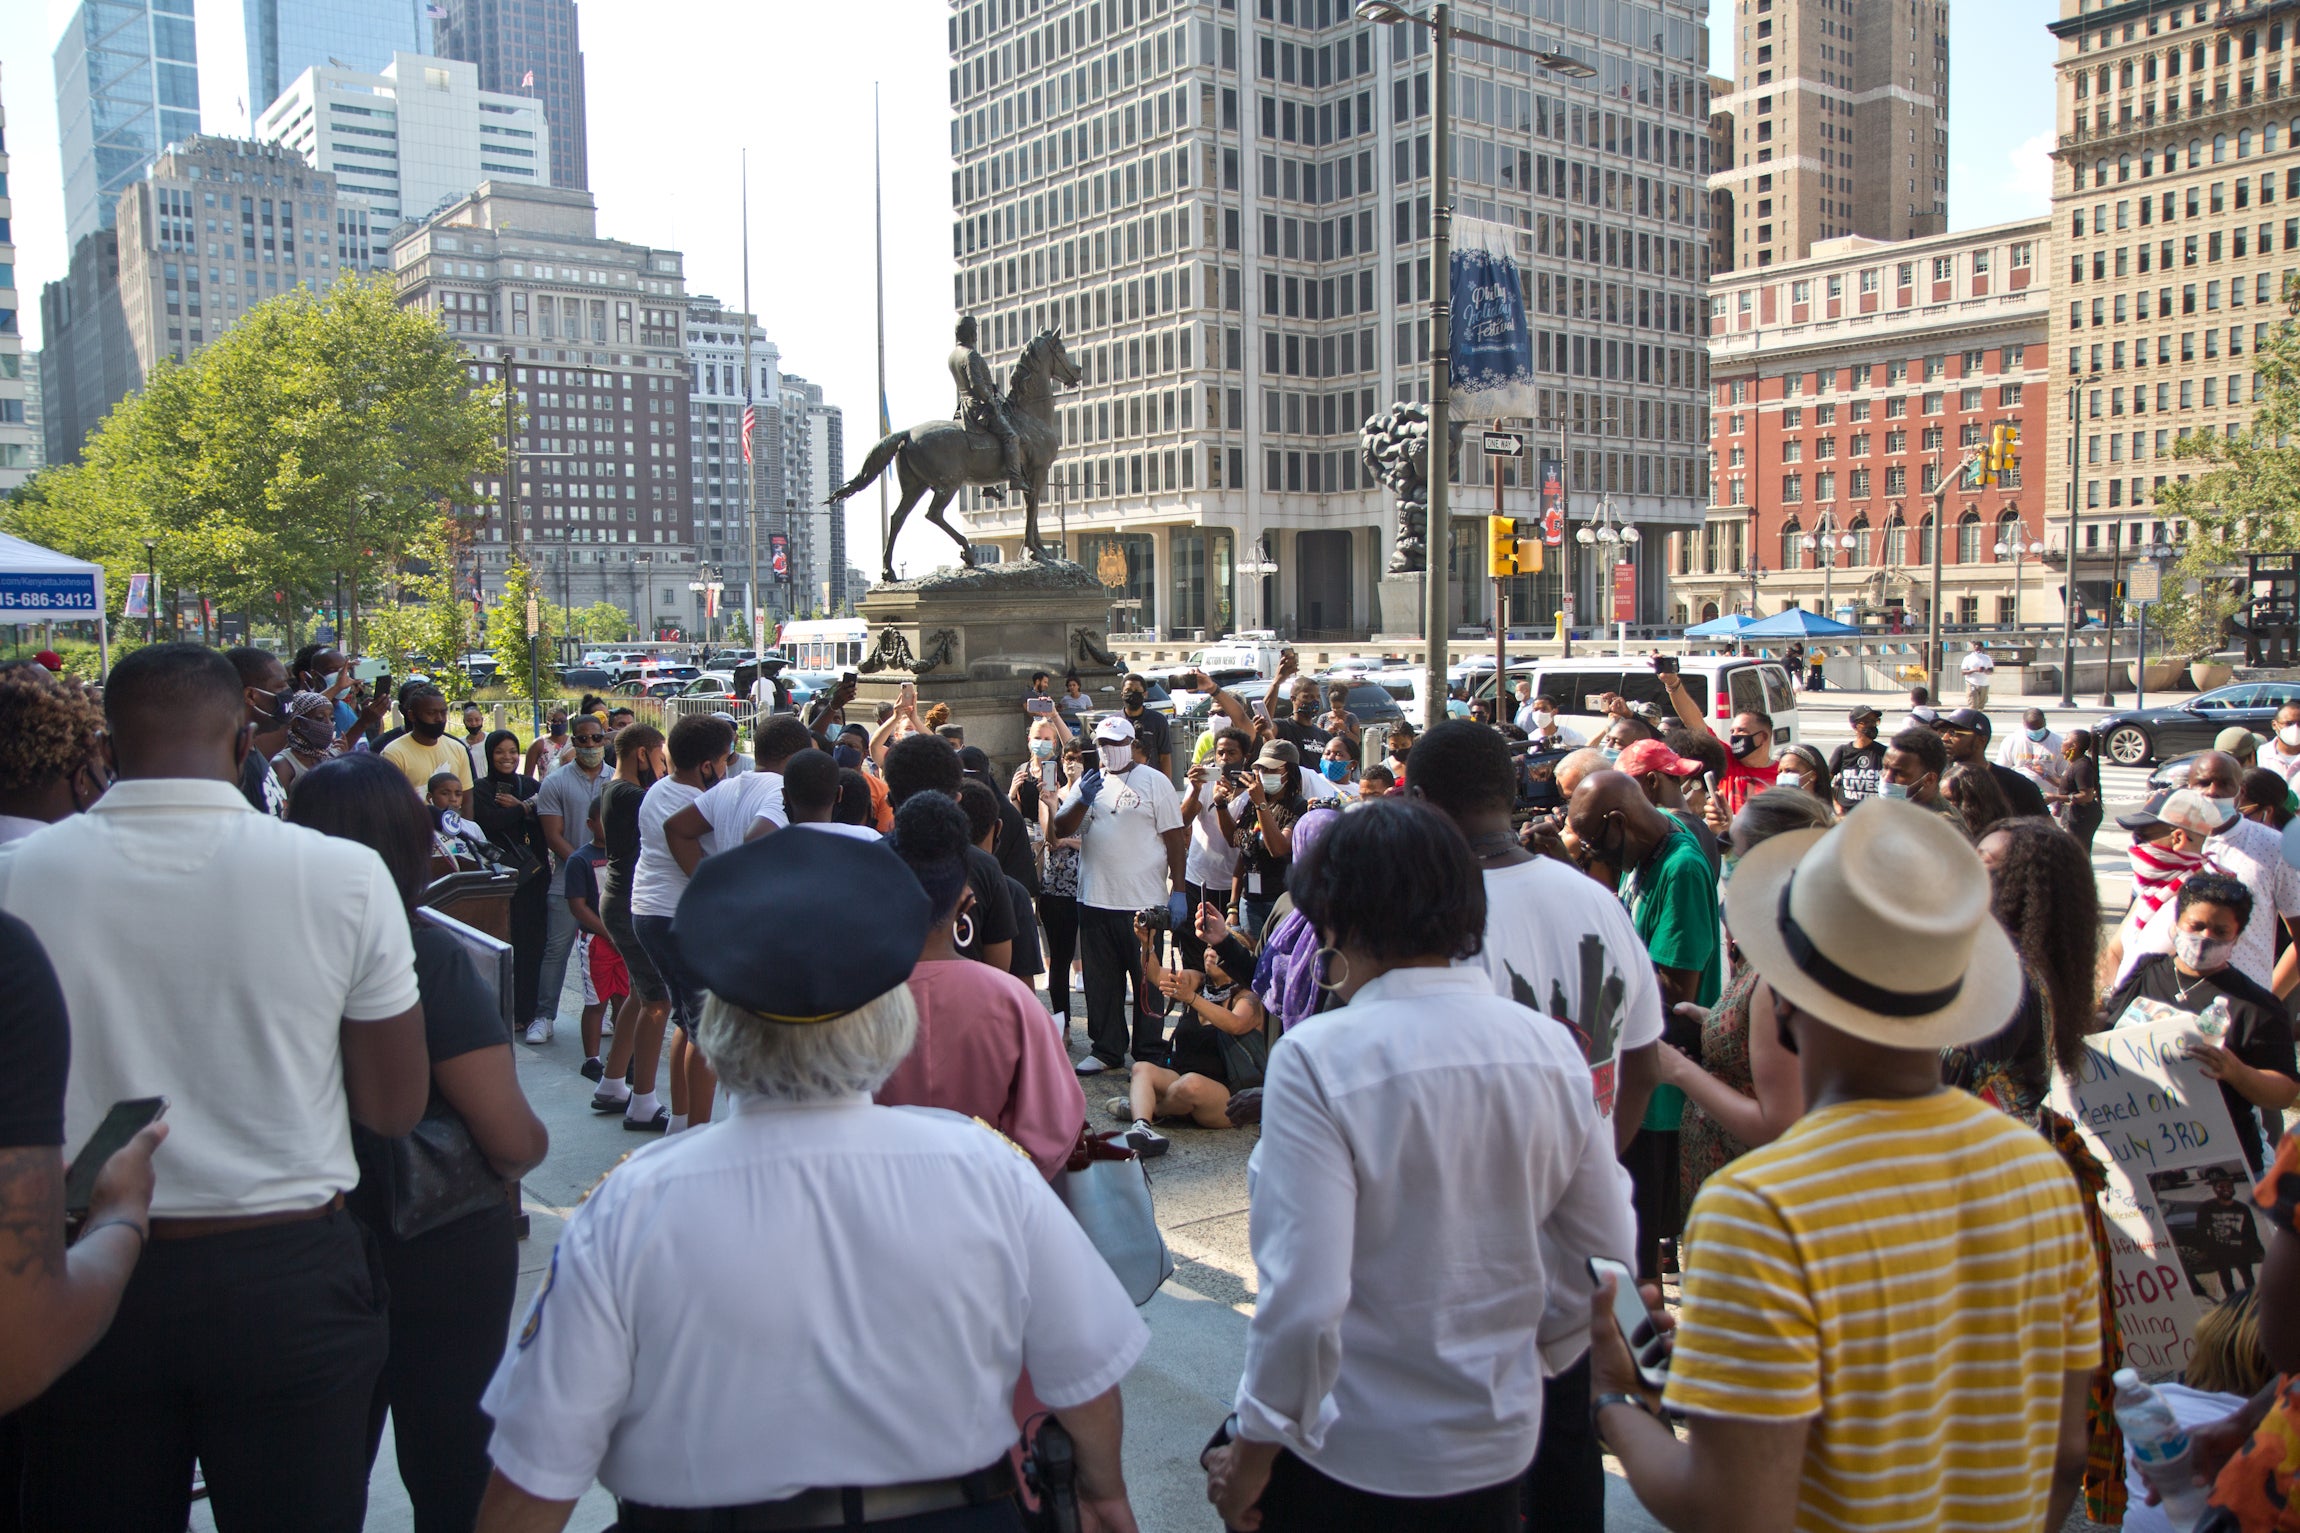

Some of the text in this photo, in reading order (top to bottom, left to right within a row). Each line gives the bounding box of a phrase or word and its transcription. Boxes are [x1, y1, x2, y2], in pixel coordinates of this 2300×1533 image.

[1472, 283, 1506, 309] Philly
[1463, 302, 1512, 327] Holiday
[1473, 318, 1515, 342] Festival
[1487, 438, 1512, 450] ONE WAY
[1206, 656, 1236, 665] ACTION NEWS
[2078, 1037, 2120, 1084] ON
[2147, 1086, 2181, 1113] on
[2090, 1120, 2209, 1168] July 3RD
[2120, 1313, 2179, 1345] illing
